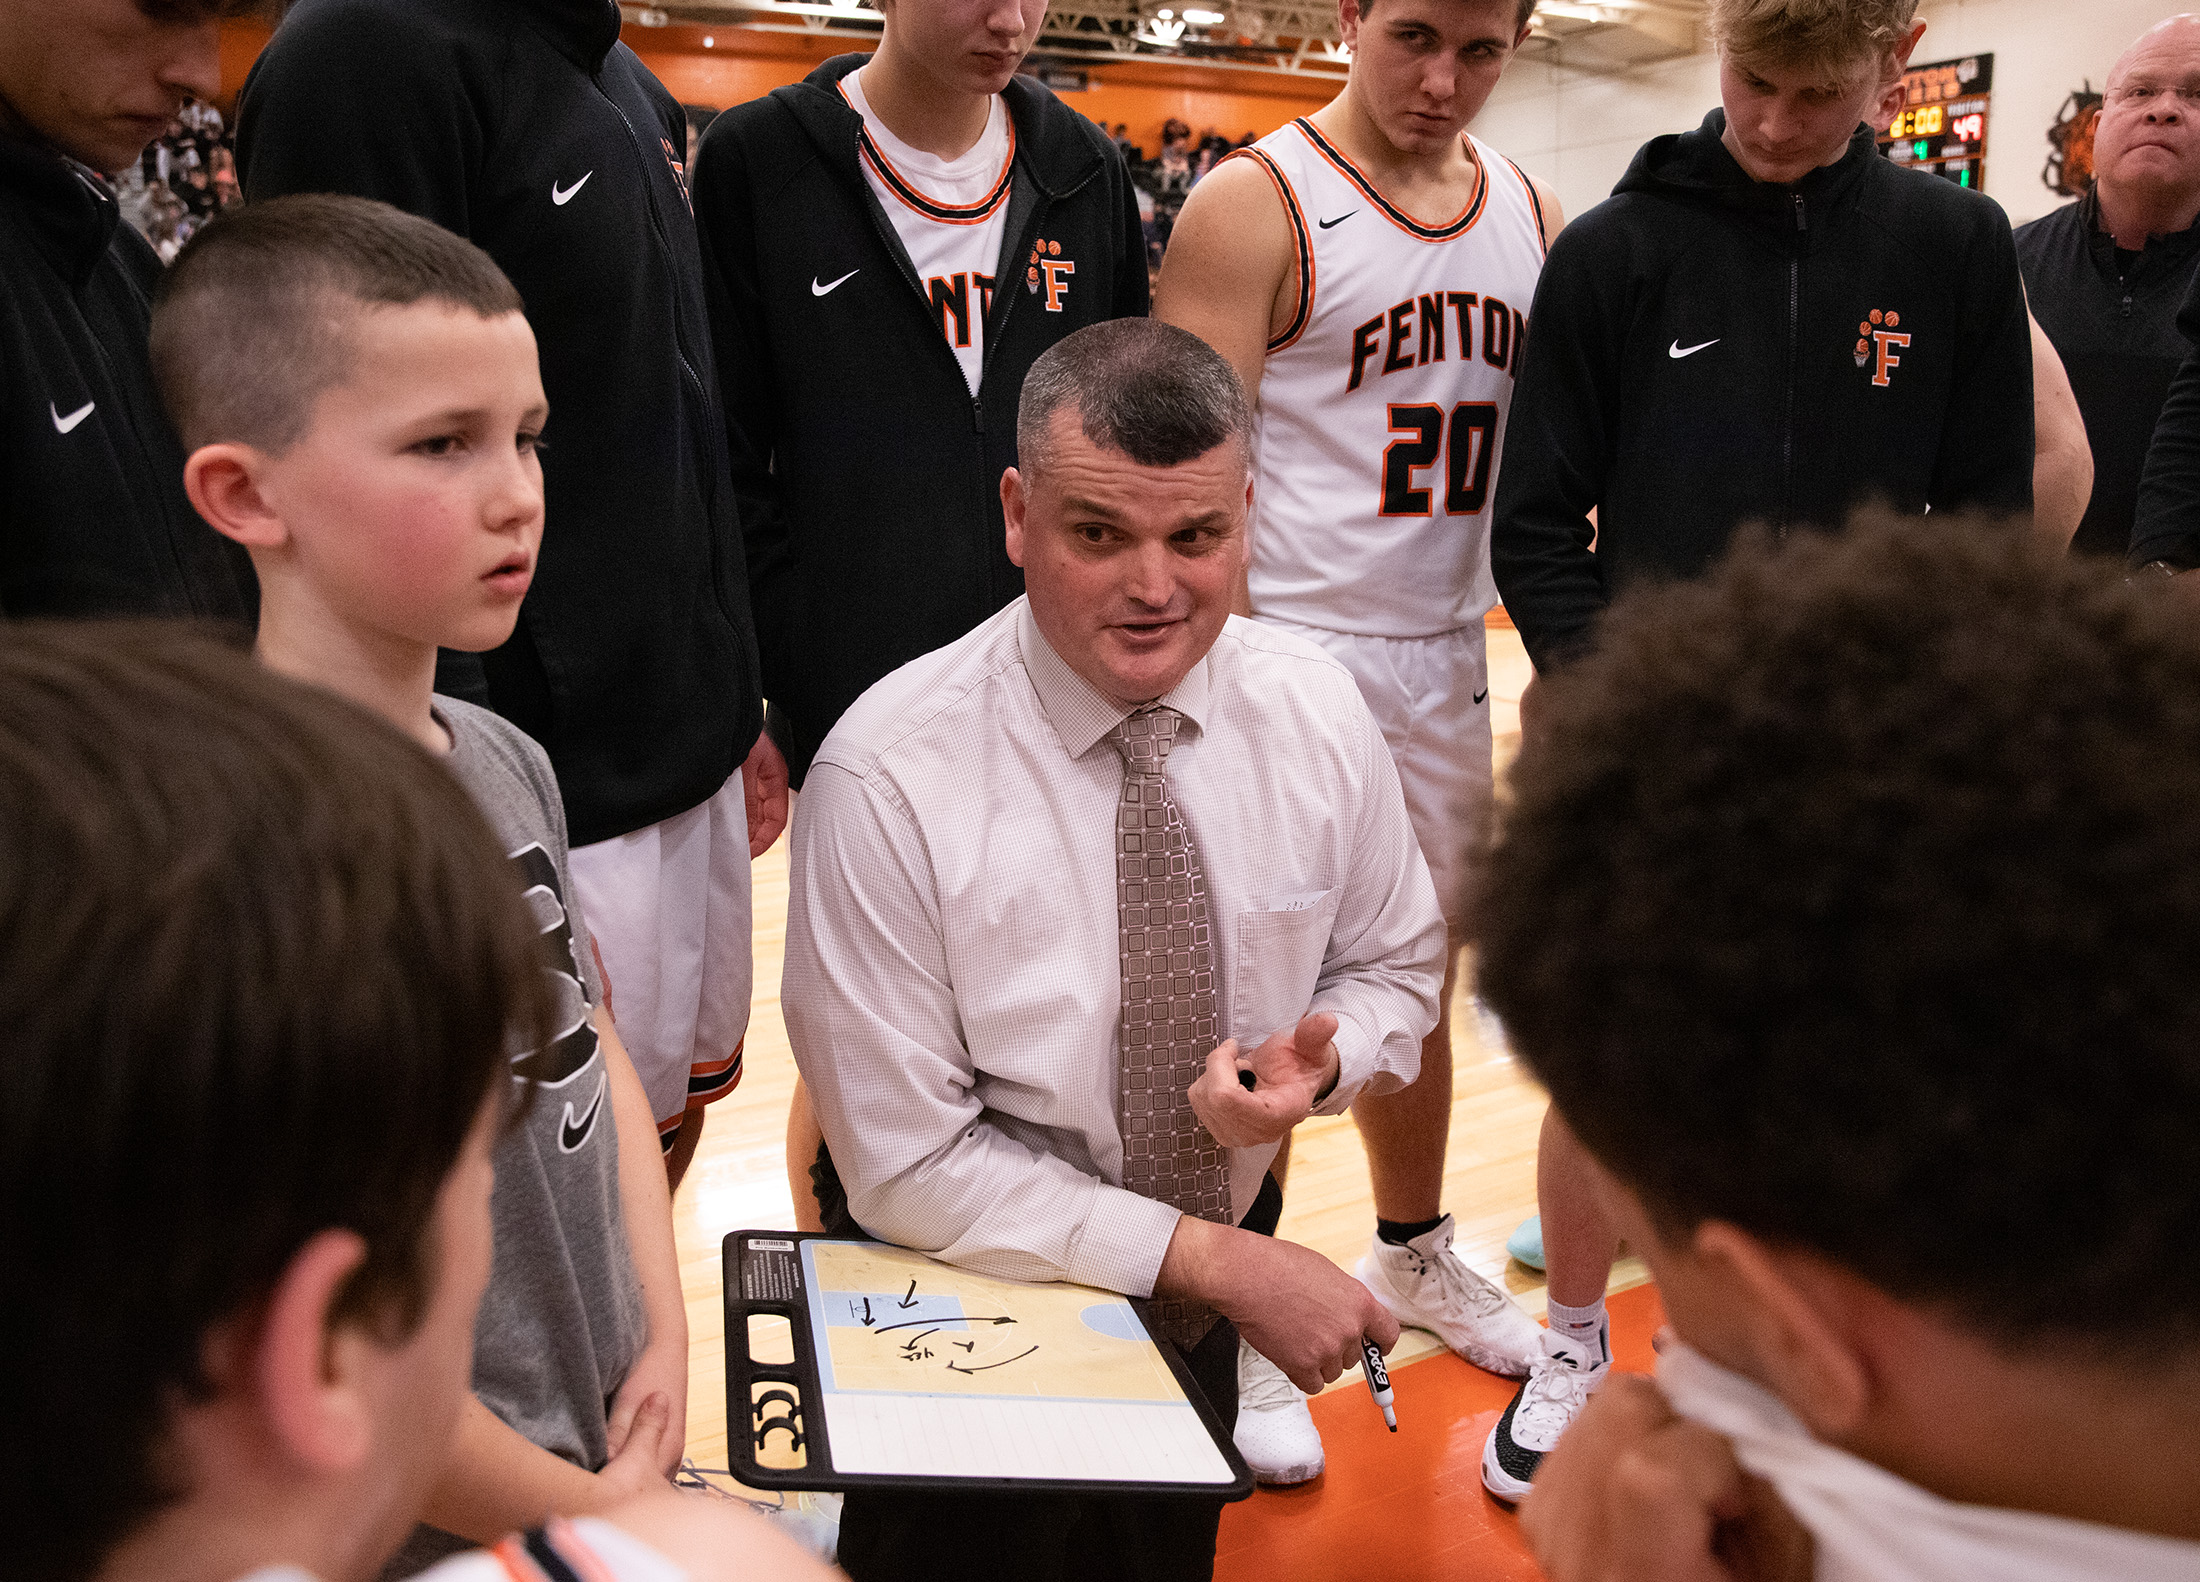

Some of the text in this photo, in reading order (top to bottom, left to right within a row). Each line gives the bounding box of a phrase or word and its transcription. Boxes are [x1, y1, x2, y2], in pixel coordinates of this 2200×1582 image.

[1953, 113, 1983, 142] 49
[1040, 259, 1075, 312] F
[1872, 330, 1911, 387] F
[1377, 401, 1500, 518] 20
[1367, 1347, 1389, 1386] EXPO
